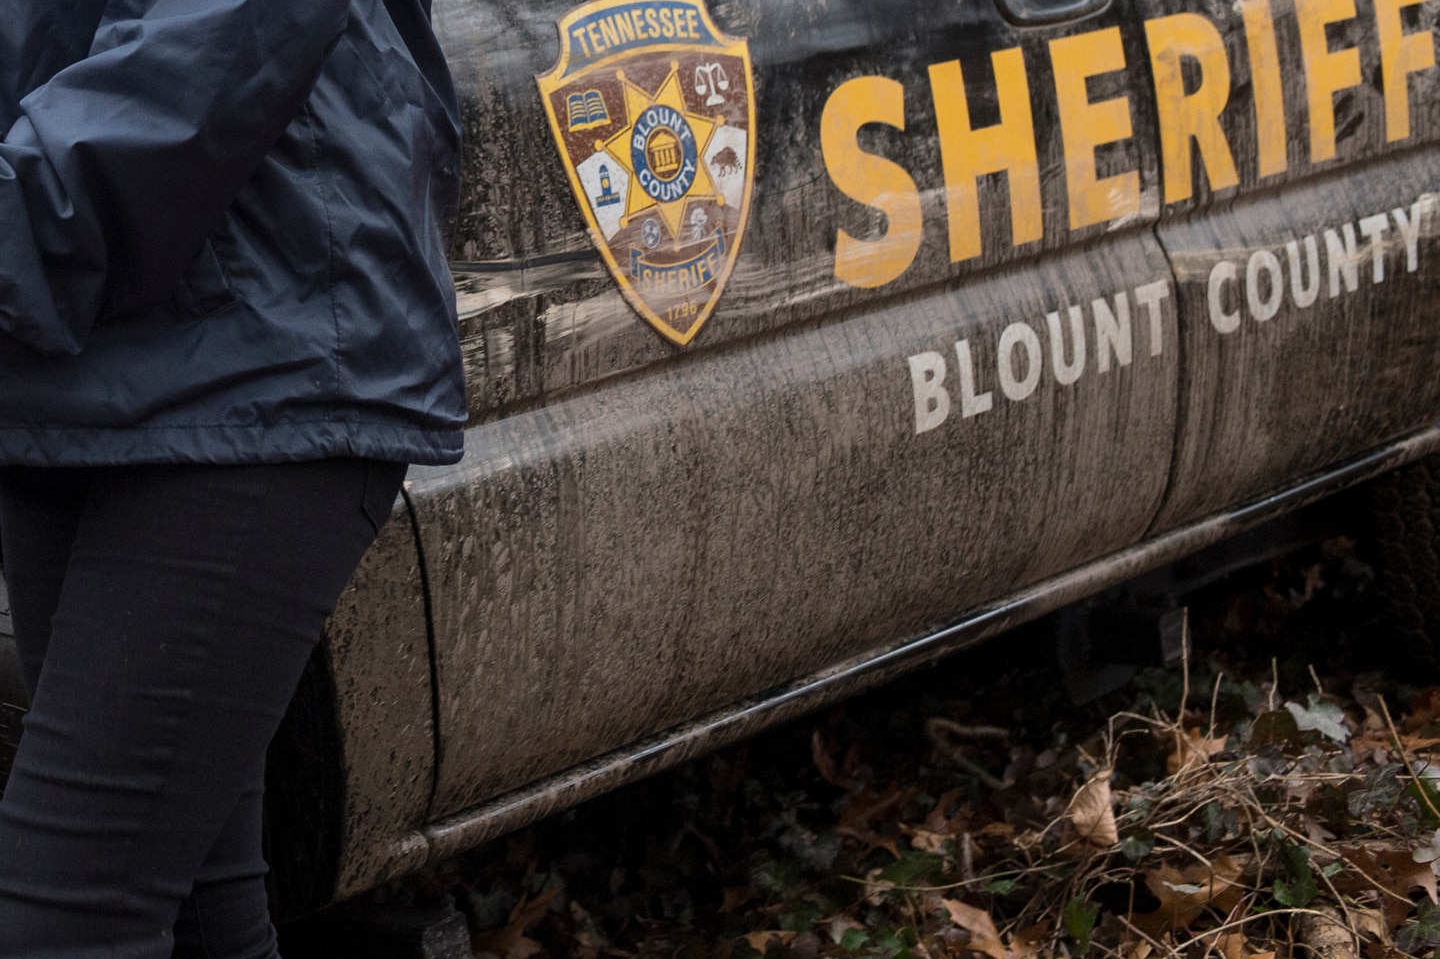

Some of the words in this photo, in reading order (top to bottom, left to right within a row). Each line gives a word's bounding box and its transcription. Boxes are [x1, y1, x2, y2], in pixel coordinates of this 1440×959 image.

[572, 7, 700, 58] TENNESSEE
[633, 108, 691, 150] BLOUNT
[639, 158, 695, 200] COUNTY
[642, 250, 716, 293] SHERIFF
[908, 280, 1169, 435] BLOUNT
[1208, 202, 1421, 334] COUNTY
